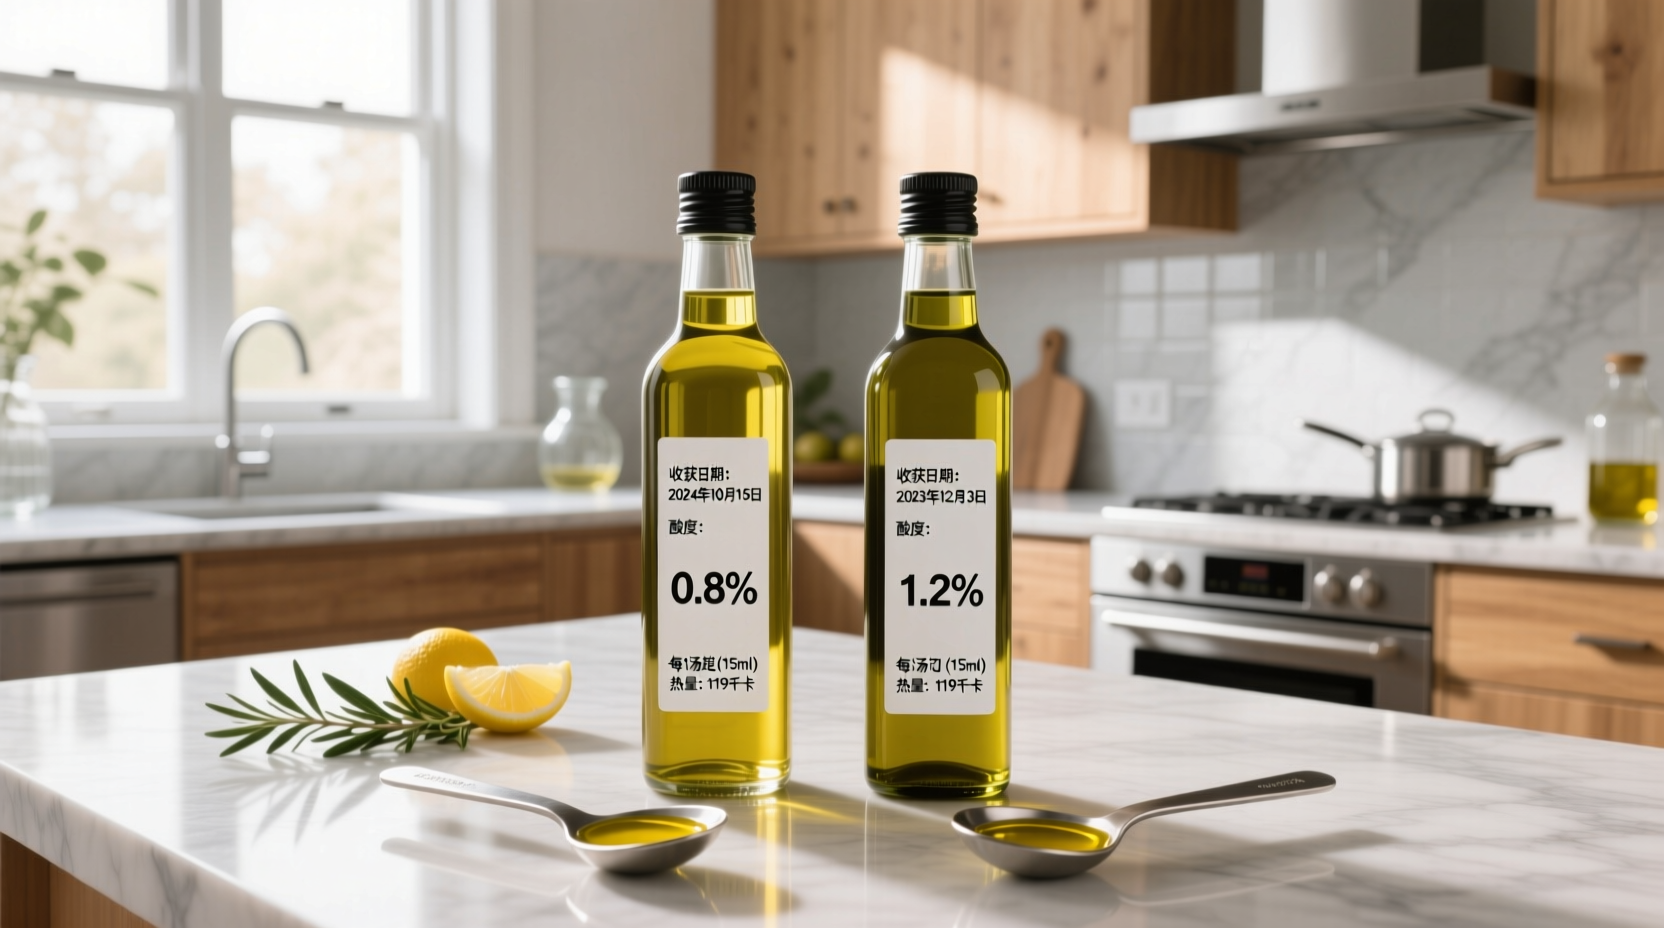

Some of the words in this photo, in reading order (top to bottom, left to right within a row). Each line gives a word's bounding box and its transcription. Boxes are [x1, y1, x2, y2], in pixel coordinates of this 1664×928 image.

[668, 486, 762, 503] 2024年10月15日
[896, 488, 986, 506] 2023年12月3日
[671, 571, 758, 605] 0.8%
[900, 573, 984, 607] 1.2%
